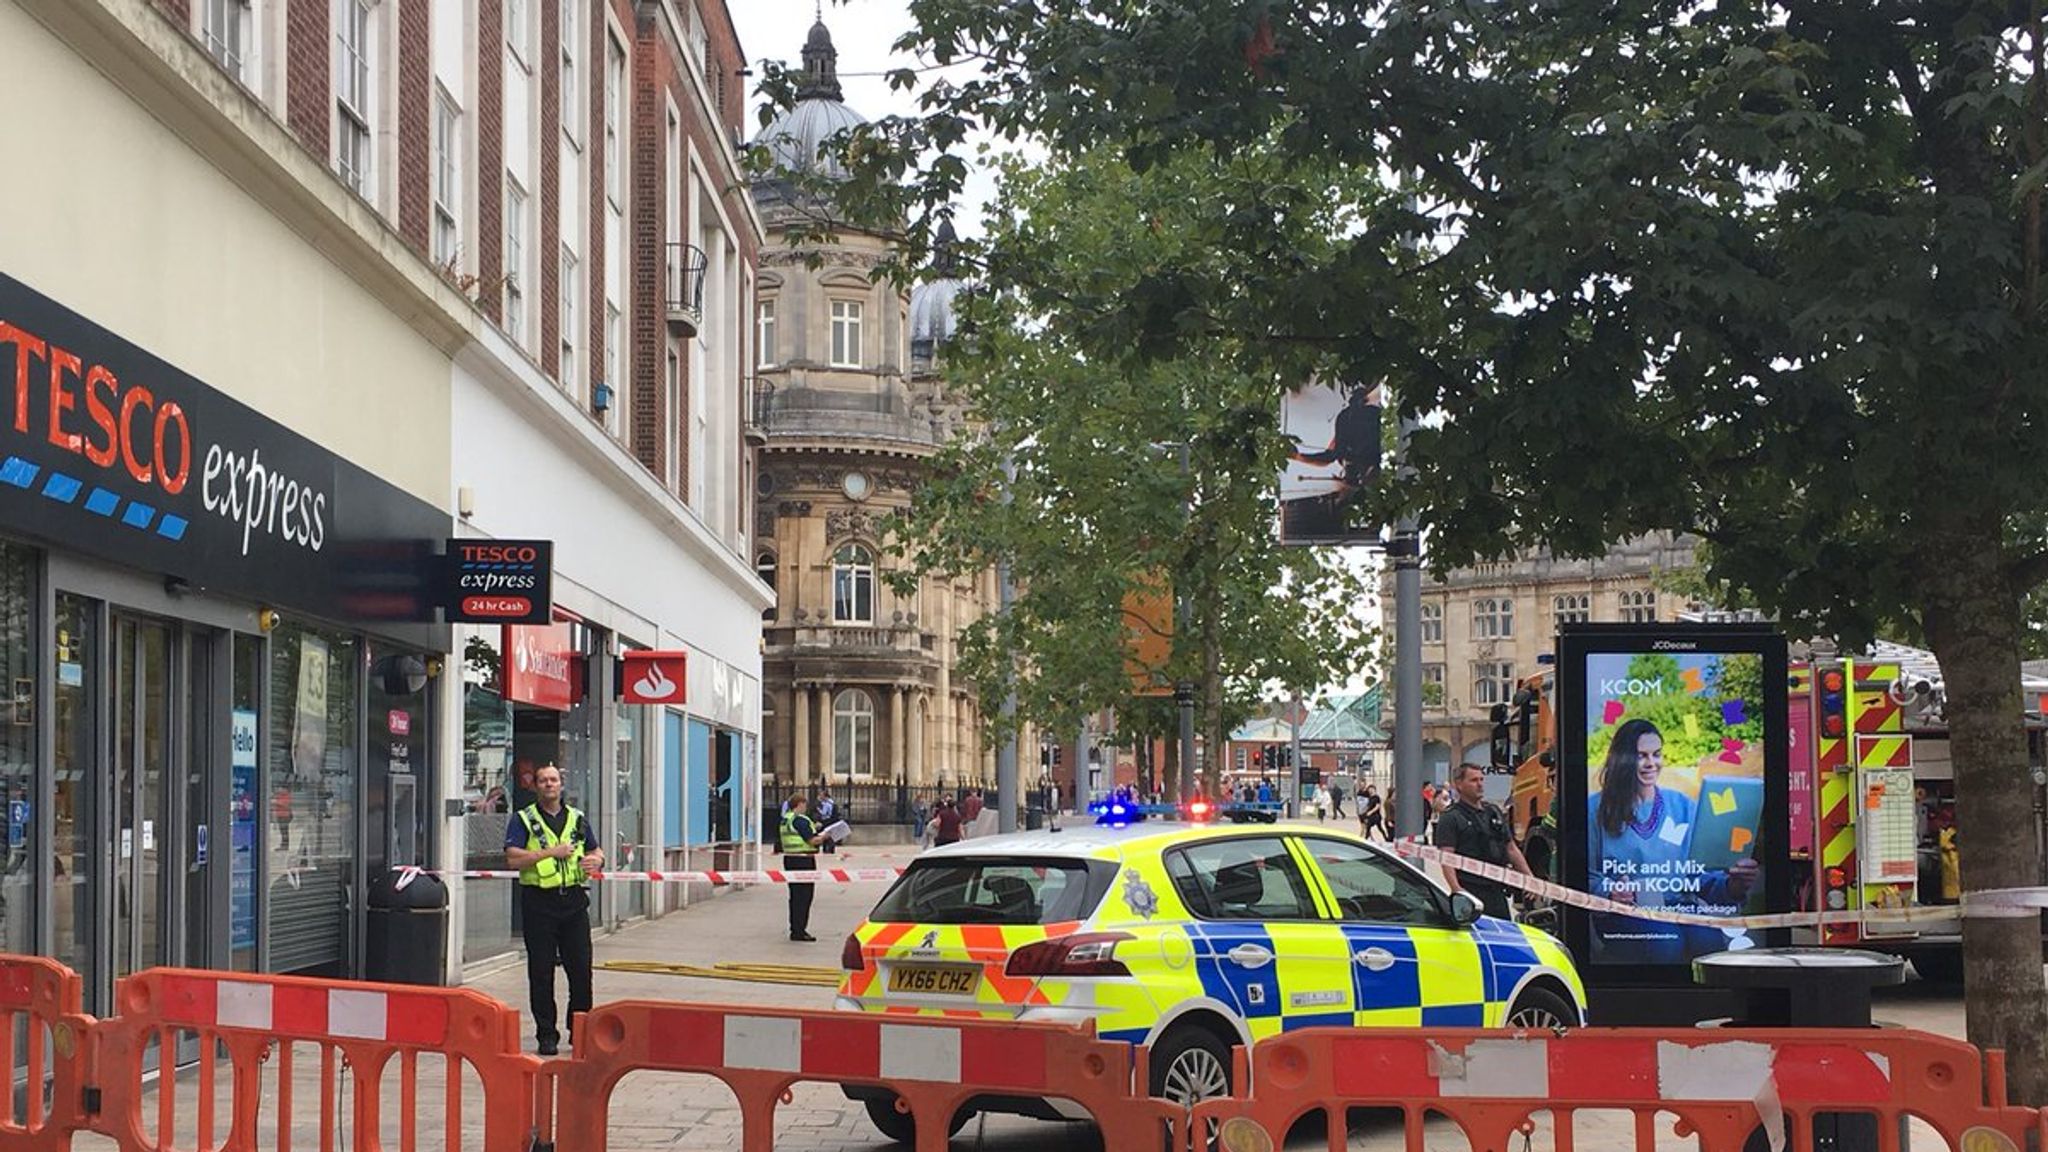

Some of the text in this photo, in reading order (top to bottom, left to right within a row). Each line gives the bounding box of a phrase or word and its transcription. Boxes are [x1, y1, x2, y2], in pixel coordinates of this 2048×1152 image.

[0, 320, 326, 555] TESCO express
[461, 546, 536, 563] TESCO
[460, 572, 536, 592] express
[471, 600, 484, 611] 24
[499, 600, 524, 611] Cash
[1652, 640, 1698, 650] JCDecaux
[1600, 678, 1661, 696] KCOM
[1602, 859, 1706, 874] Pick and Mix
[1602, 877, 1700, 892] from KCOM
[1660, 903, 1695, 914] perfect
[1697, 903, 1737, 915] package
[897, 969, 972, 991] YX66 CHZ
